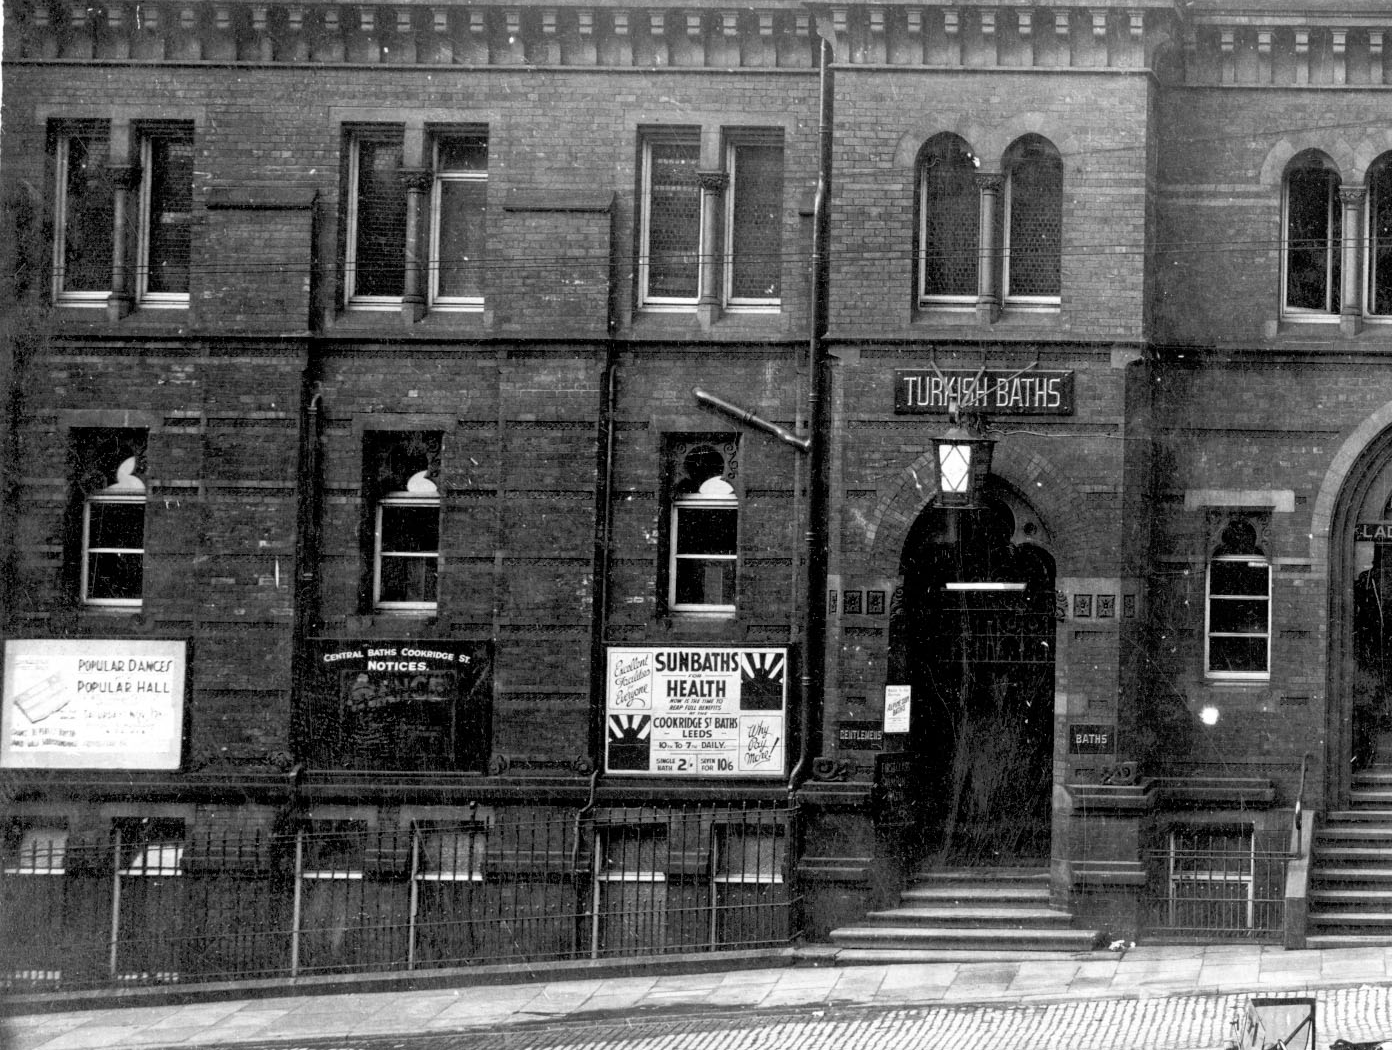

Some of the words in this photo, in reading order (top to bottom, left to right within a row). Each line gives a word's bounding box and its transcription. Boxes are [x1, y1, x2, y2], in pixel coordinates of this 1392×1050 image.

[903, 376, 988, 407] TURKISH
[996, 377, 1061, 407] BATHS
[323, 650, 364, 662] CENTRAL
[367, 648, 397, 657] BATHS
[401, 647, 454, 661] COOKRIDGE
[655, 651, 739, 672] SUNBATHS
[78, 659, 125, 672] POPULAR
[128, 659, 173, 672] DANCES
[77, 681, 131, 693] POPULAR
[137, 681, 170, 693] HALL
[666, 679, 726, 697] HEALTH
[615, 683, 649, 707] Everyone
[653, 717, 702, 729] COOKRIDGE
[714, 717, 738, 729] BATHS
[747, 719, 773, 739] Why
[682, 729, 713, 738] LEEDS
[1076, 734, 1108, 744] BATHS
[748, 737, 768, 752] Pay
